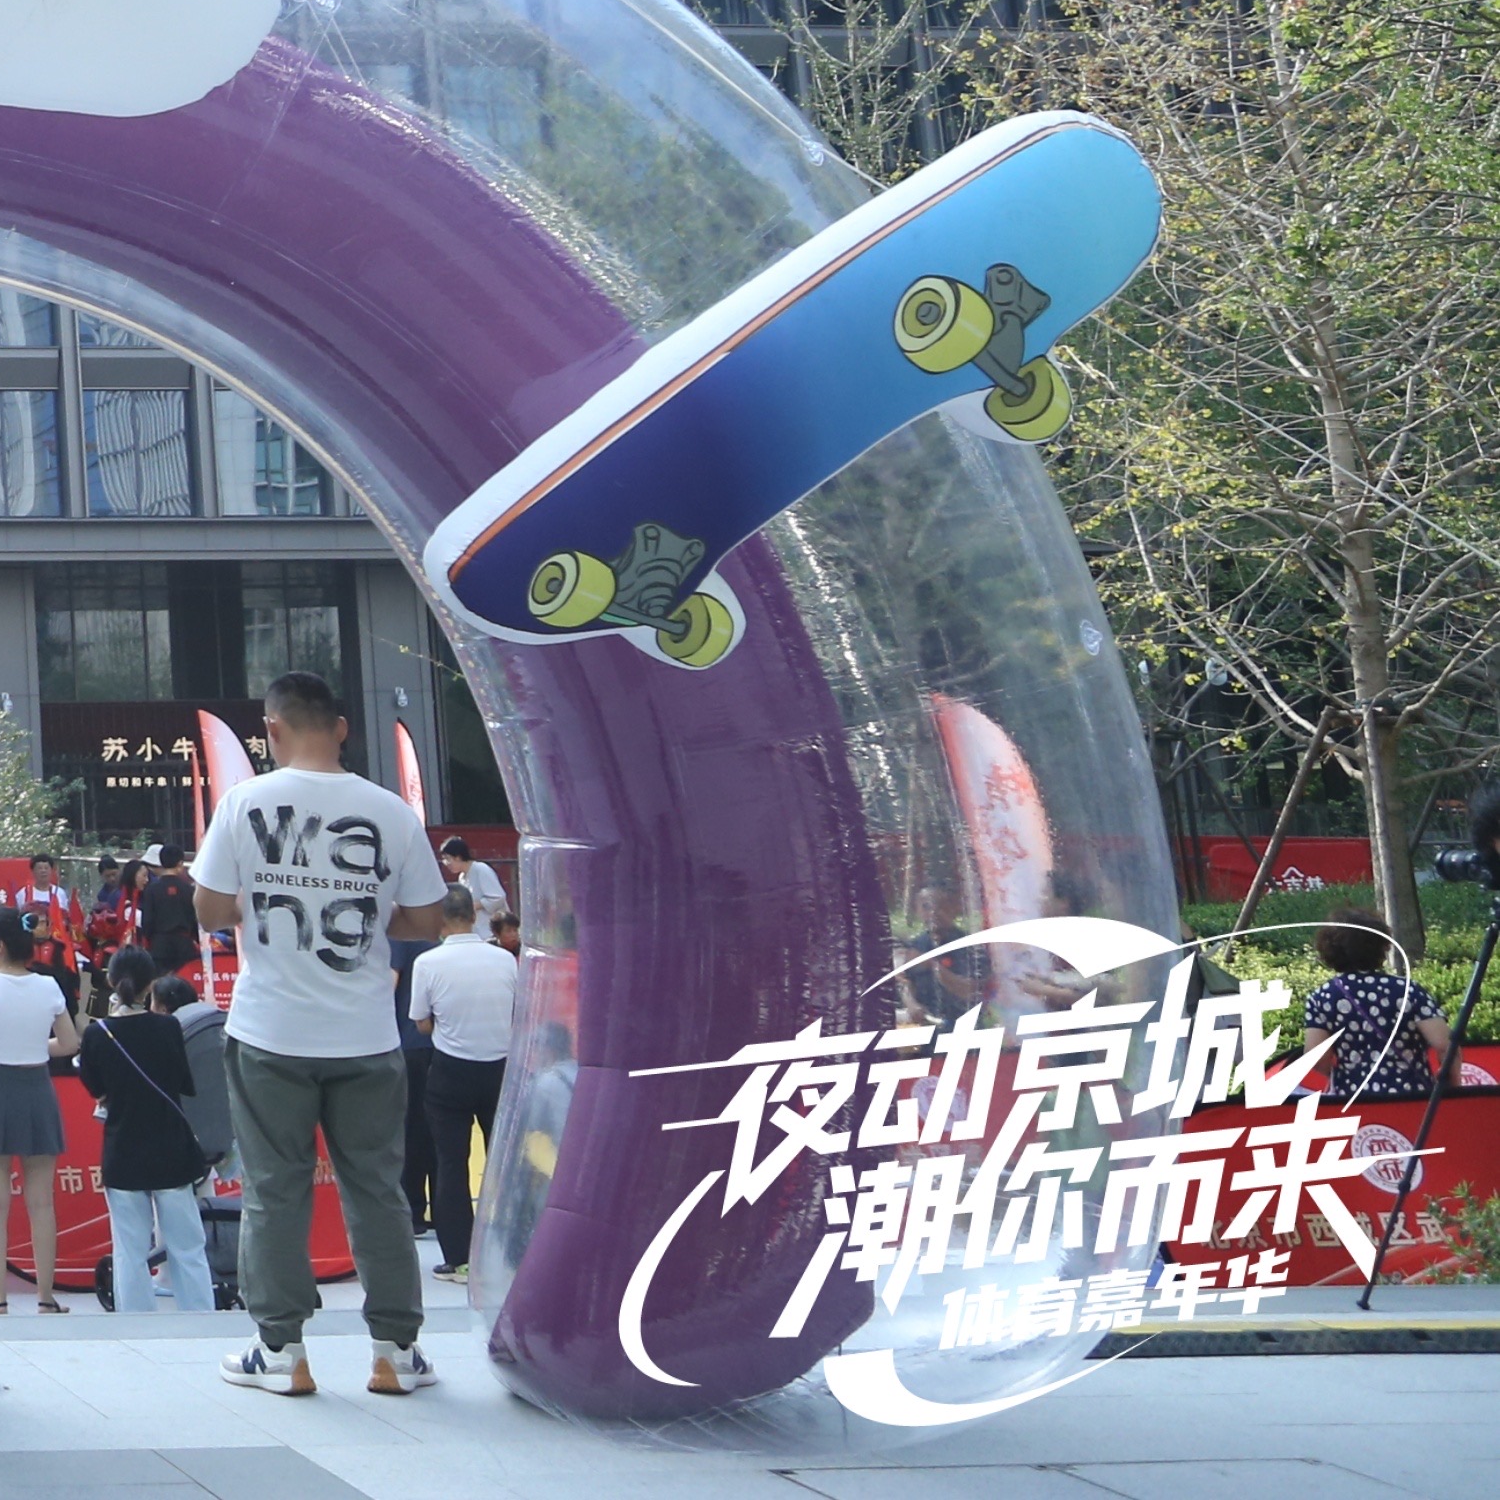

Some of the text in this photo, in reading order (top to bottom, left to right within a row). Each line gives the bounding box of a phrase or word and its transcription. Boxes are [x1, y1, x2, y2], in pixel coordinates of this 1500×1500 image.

[101, 736, 267, 762] 苏小牛肉
[255, 872, 379, 894] BONELESS BRUCE
